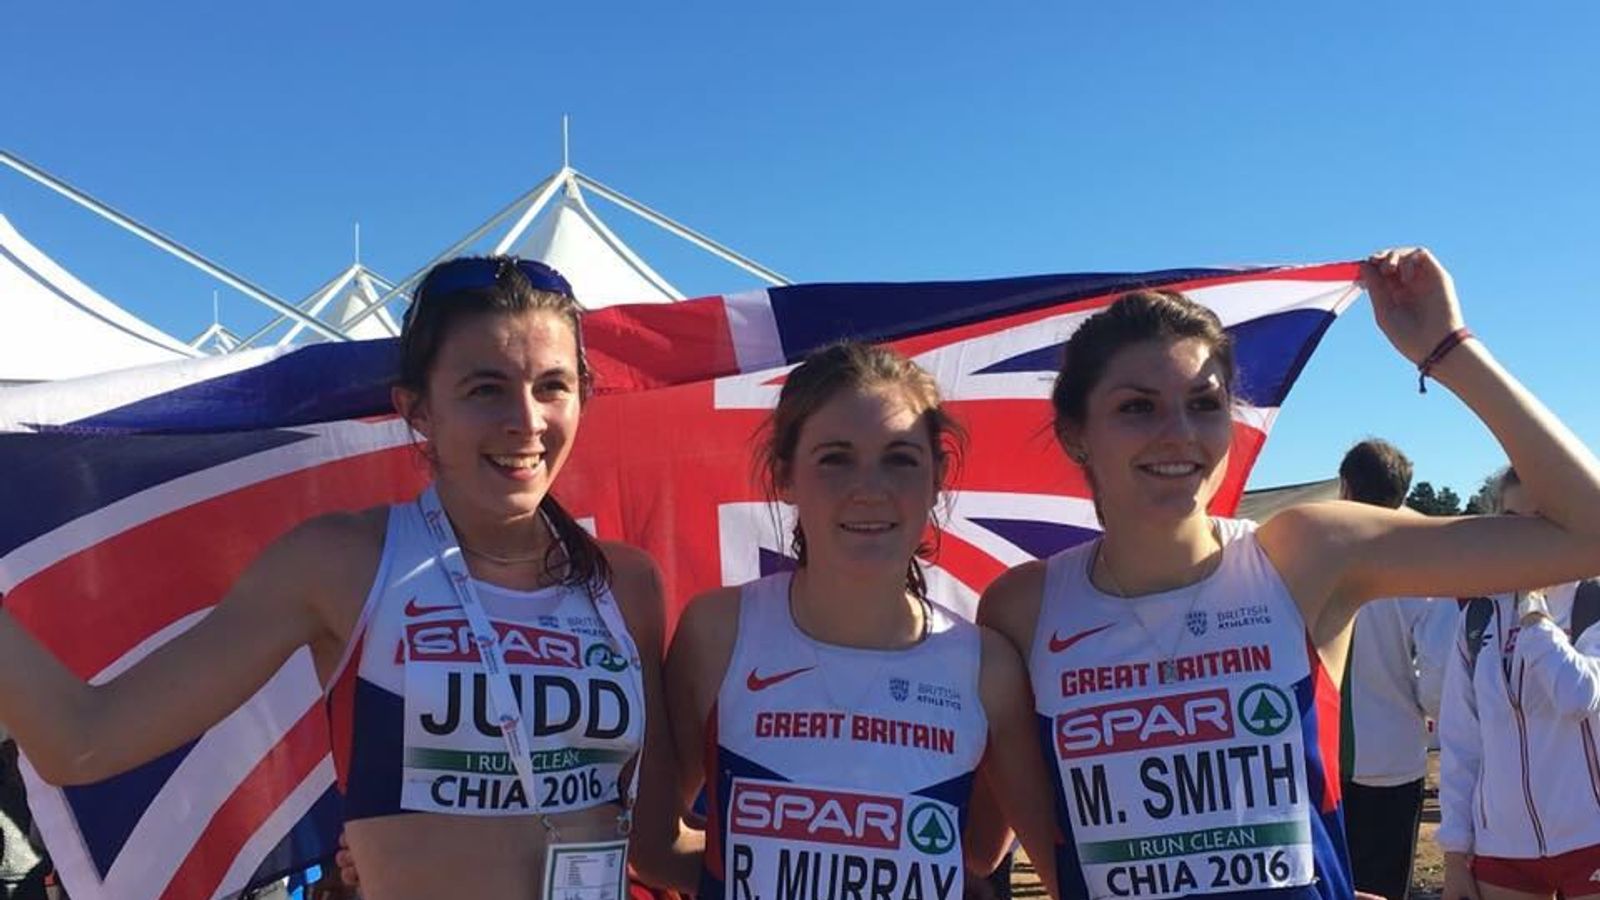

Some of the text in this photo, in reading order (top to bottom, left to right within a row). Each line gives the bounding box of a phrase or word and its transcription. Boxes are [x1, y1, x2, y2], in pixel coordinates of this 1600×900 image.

[1061, 663, 1150, 697] GREAT
[420, 672, 630, 740] JUDD
[1062, 697, 1228, 750] SPAR
[755, 712, 955, 754] GREAT BRITAIN
[431, 768, 602, 809] CHIA 2016
[1070, 743, 1298, 827] M. SMITH
[735, 791, 898, 842] SPAR
[1129, 828, 1256, 857] I RUN CLEAN
[776, 849, 958, 900] MURRAY
[1107, 850, 1290, 897] CHIA 2016
